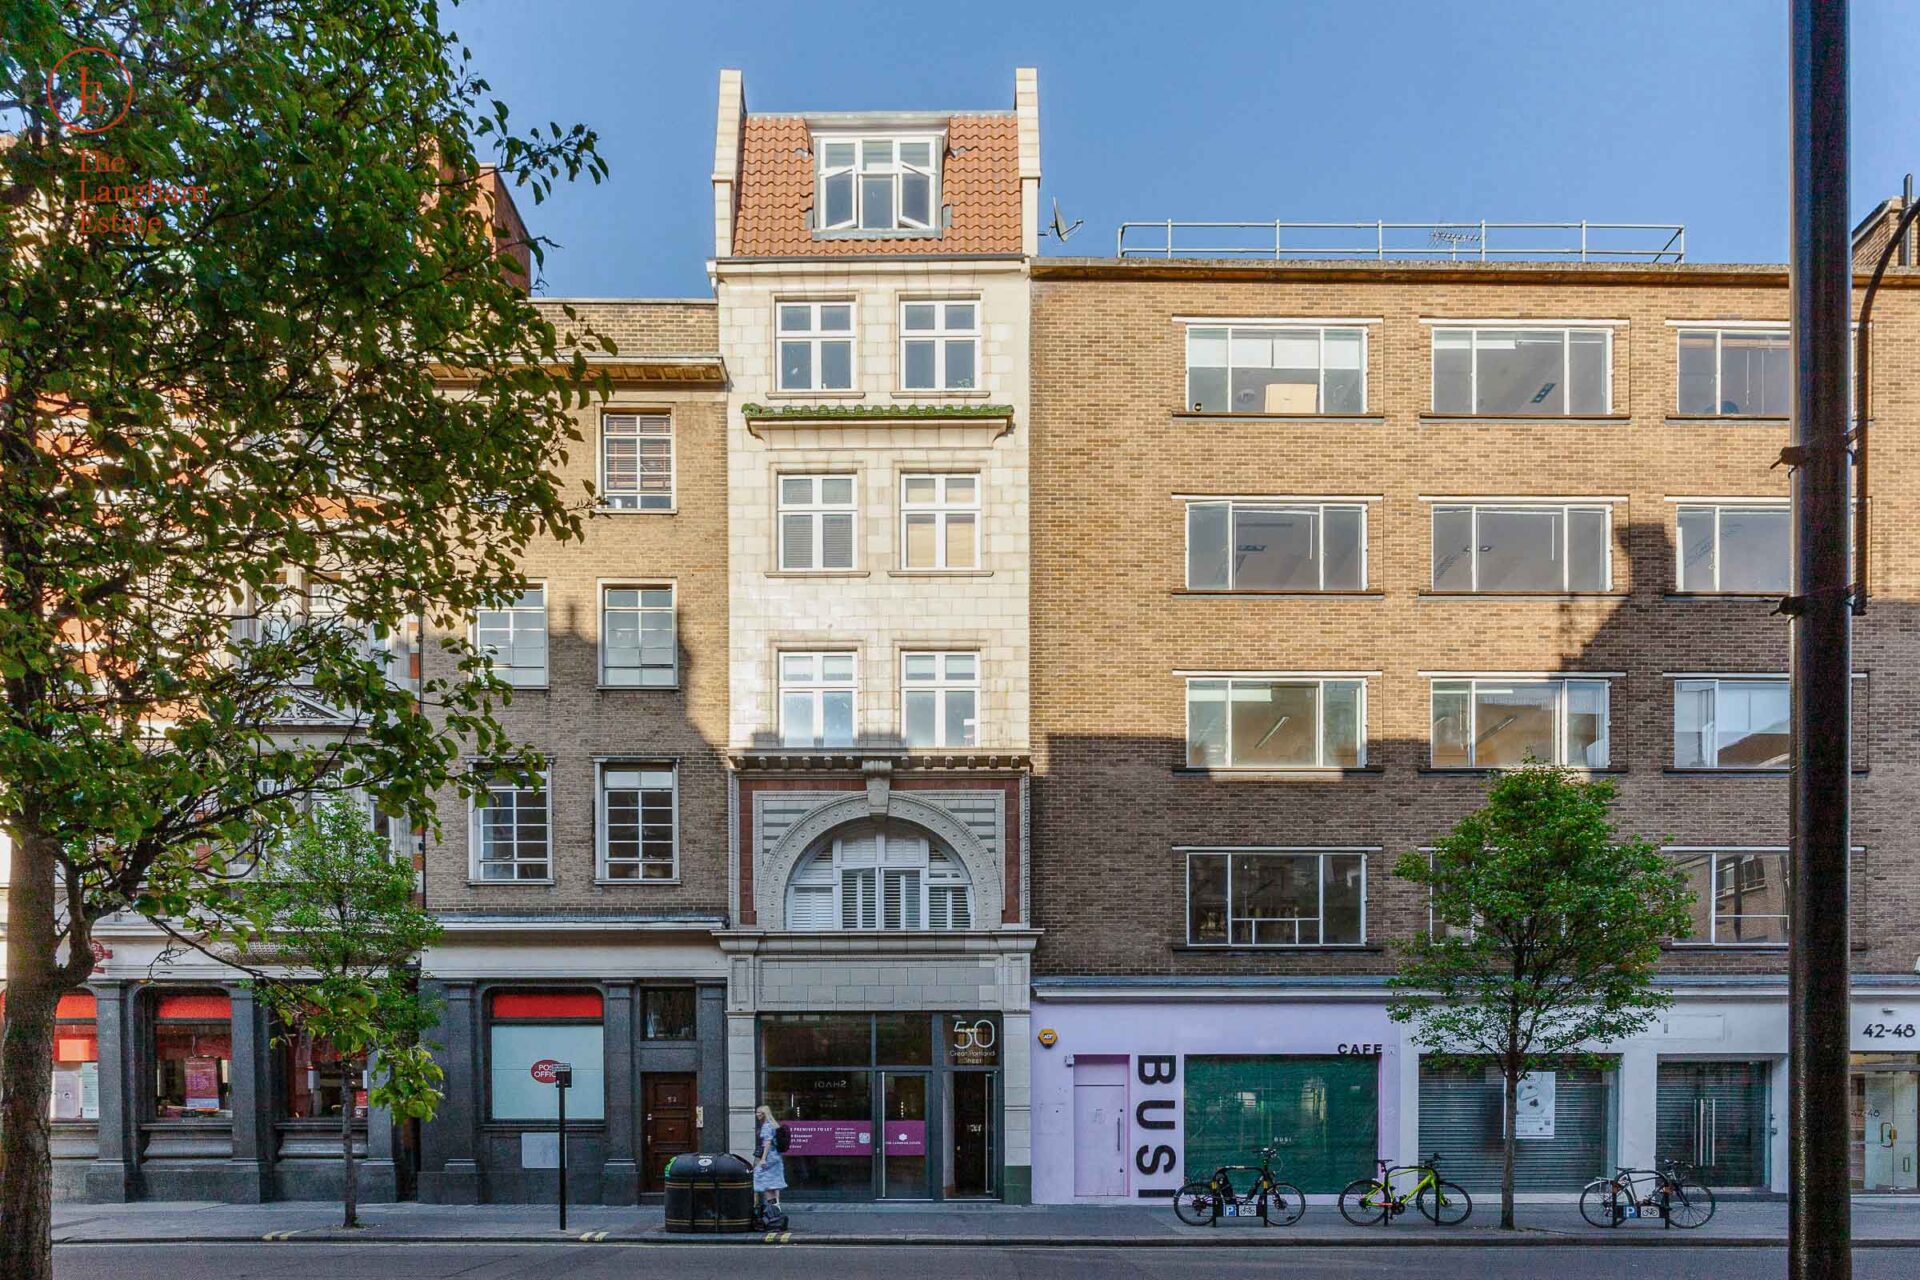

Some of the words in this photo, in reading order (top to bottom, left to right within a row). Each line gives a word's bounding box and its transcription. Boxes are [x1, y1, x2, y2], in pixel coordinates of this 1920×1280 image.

[953, 1019, 995, 1049] 50
[1862, 1023, 1917, 1038] 42-48
[1337, 1043, 1383, 1055] CAFE
[533, 1070, 557, 1078] OFFIC
[1135, 1054, 1177, 1199] BUSI
[1225, 1205, 1235, 1216] P
[1626, 1206, 1636, 1218] P
